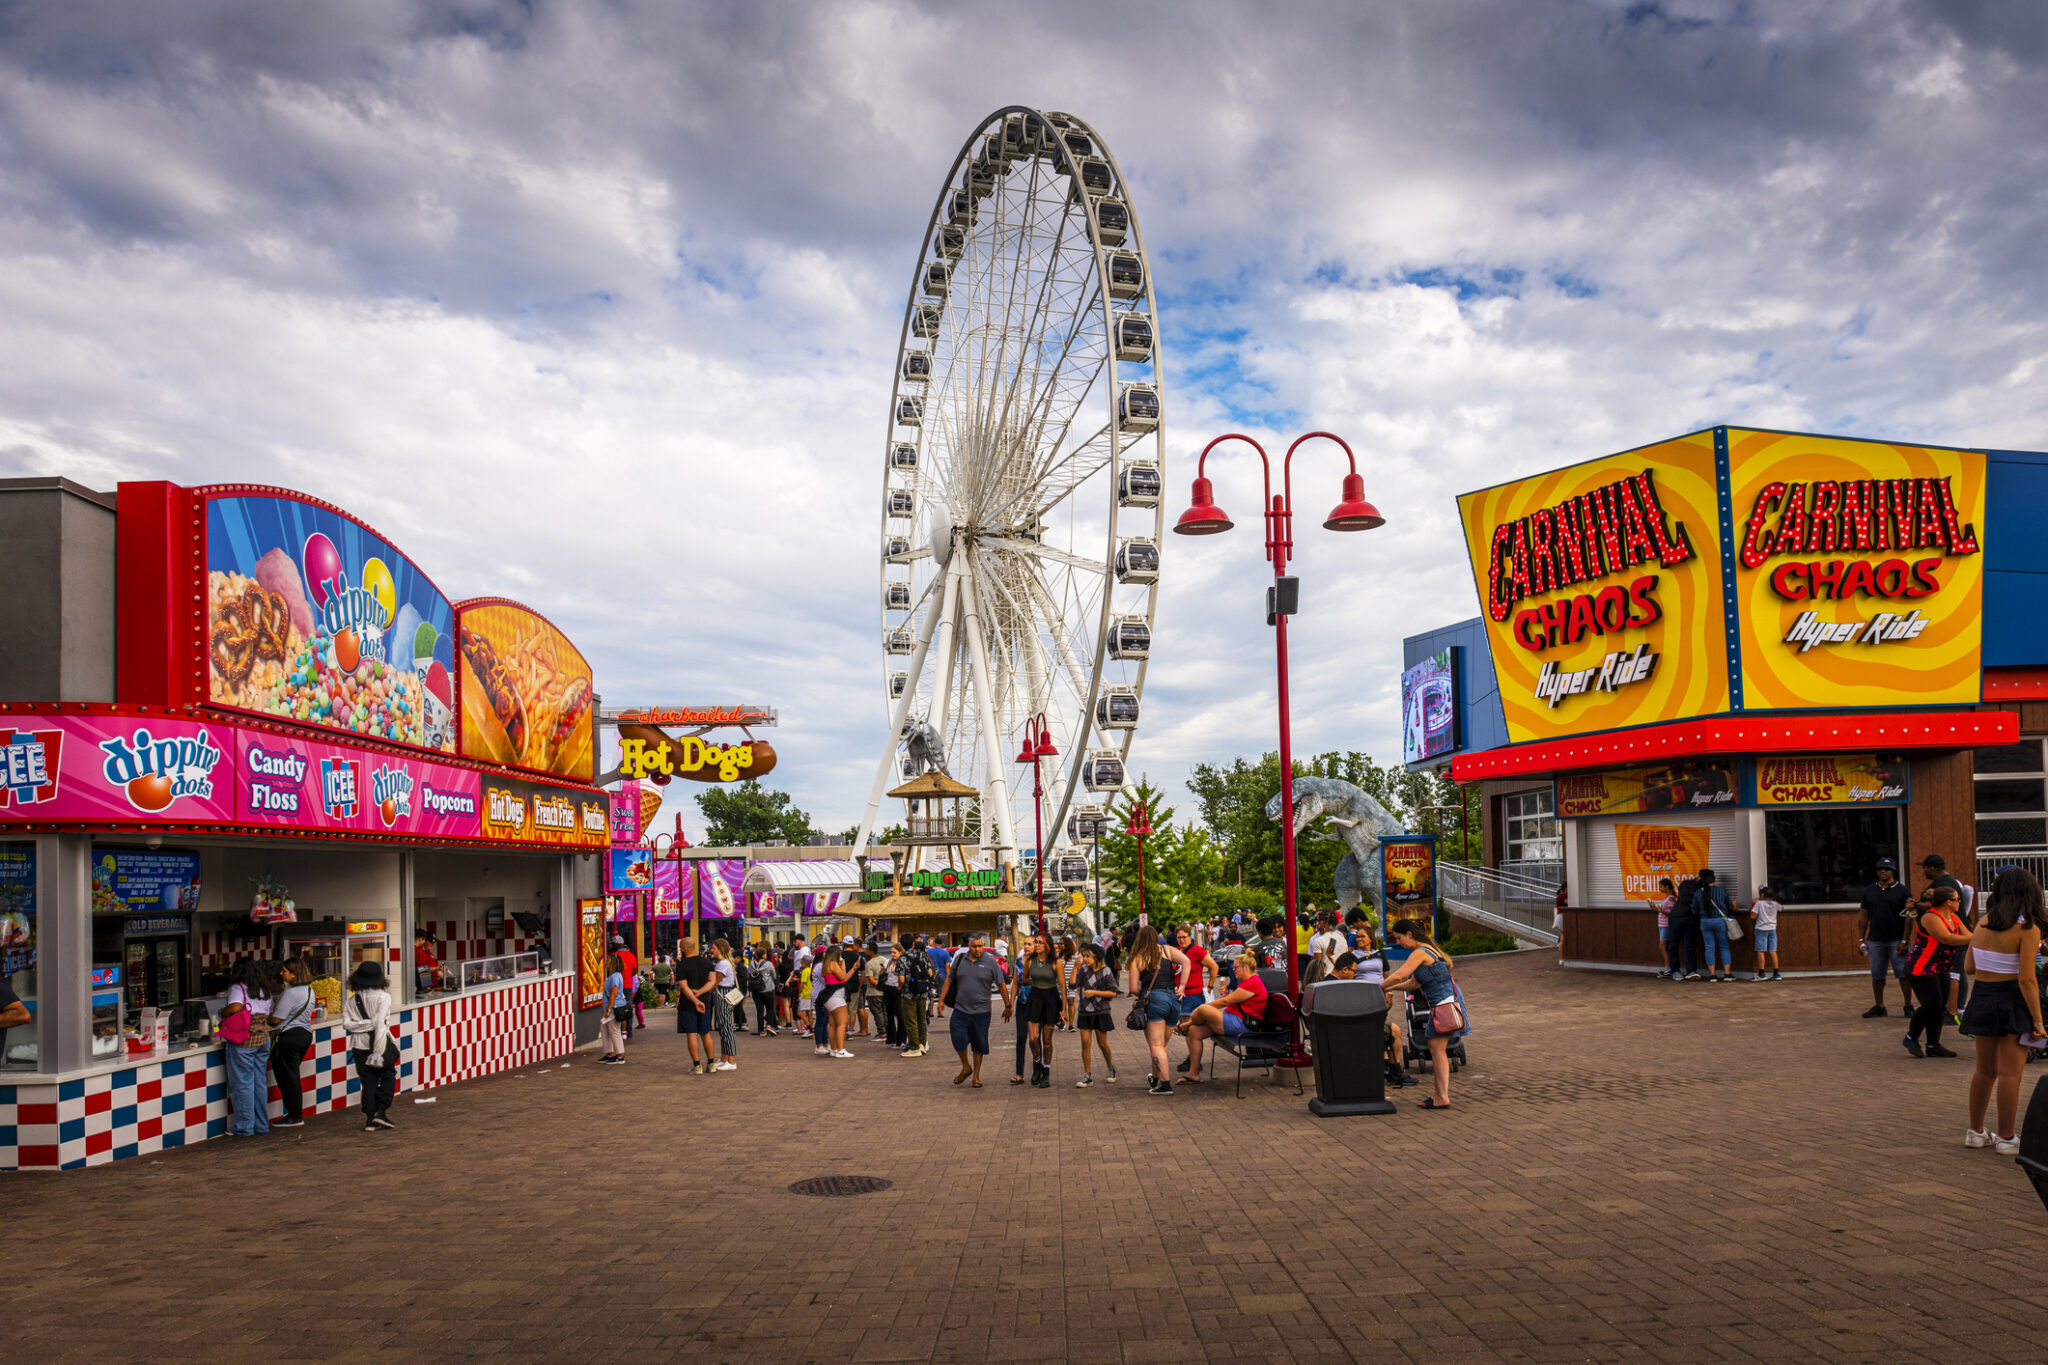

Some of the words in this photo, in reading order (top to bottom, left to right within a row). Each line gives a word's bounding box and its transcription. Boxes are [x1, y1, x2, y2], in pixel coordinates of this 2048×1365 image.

[1741, 475, 1980, 570] CARNIVAL
[1488, 468, 1697, 623] CARNIVAL
[1770, 557, 1943, 600] CHAOS
[1513, 575, 1662, 651] CHAOS
[1785, 610, 1864, 652] Hyper
[1861, 610, 1930, 645] Ride
[360, 632, 384, 661] dots
[1535, 661, 1595, 708] Hyper
[1595, 643, 1658, 692] Ride
[626, 705, 757, 723] charbroiled
[101, 729, 218, 784] dippin'
[249, 747, 306, 783] Candy
[619, 738, 673, 779] Hot
[680, 736, 754, 782] Dogs
[171, 774, 211, 797] dots
[326, 769, 357, 805] ICEE
[1761, 757, 1846, 790] CARNIVAL
[250, 783, 298, 812] Floss
[423, 788, 475, 815] Popcorn
[1558, 774, 1609, 805] CARNIVAL
[1690, 791, 1713, 807] Hyper
[1713, 789, 1734, 804] Ride
[1772, 786, 1833, 802] CHAOS
[1848, 785, 1877, 802] Hyper
[1877, 784, 1904, 799] Ride
[490, 792, 505, 822] Hot
[506, 794, 524, 830] Dogs
[535, 799, 558, 826] French
[558, 801, 575, 828] Fries
[583, 804, 605, 832] Poutine
[1565, 799, 1602, 814] CHAOS
[1386, 846, 1429, 862] CARNIVAL
[1637, 829, 1685, 854] CARNIVAL
[1392, 859, 1424, 869] CHAOS
[1643, 851, 1678, 863] CHAOS
[912, 870, 1000, 889] DINOSAUR
[1626, 874, 1670, 893] OPENIN
[660, 899, 687, 914] Strik!
[930, 890, 980, 899] ADVENTURE
[981, 889, 1001, 897] GOLF
[127, 919, 147, 930] COLD
